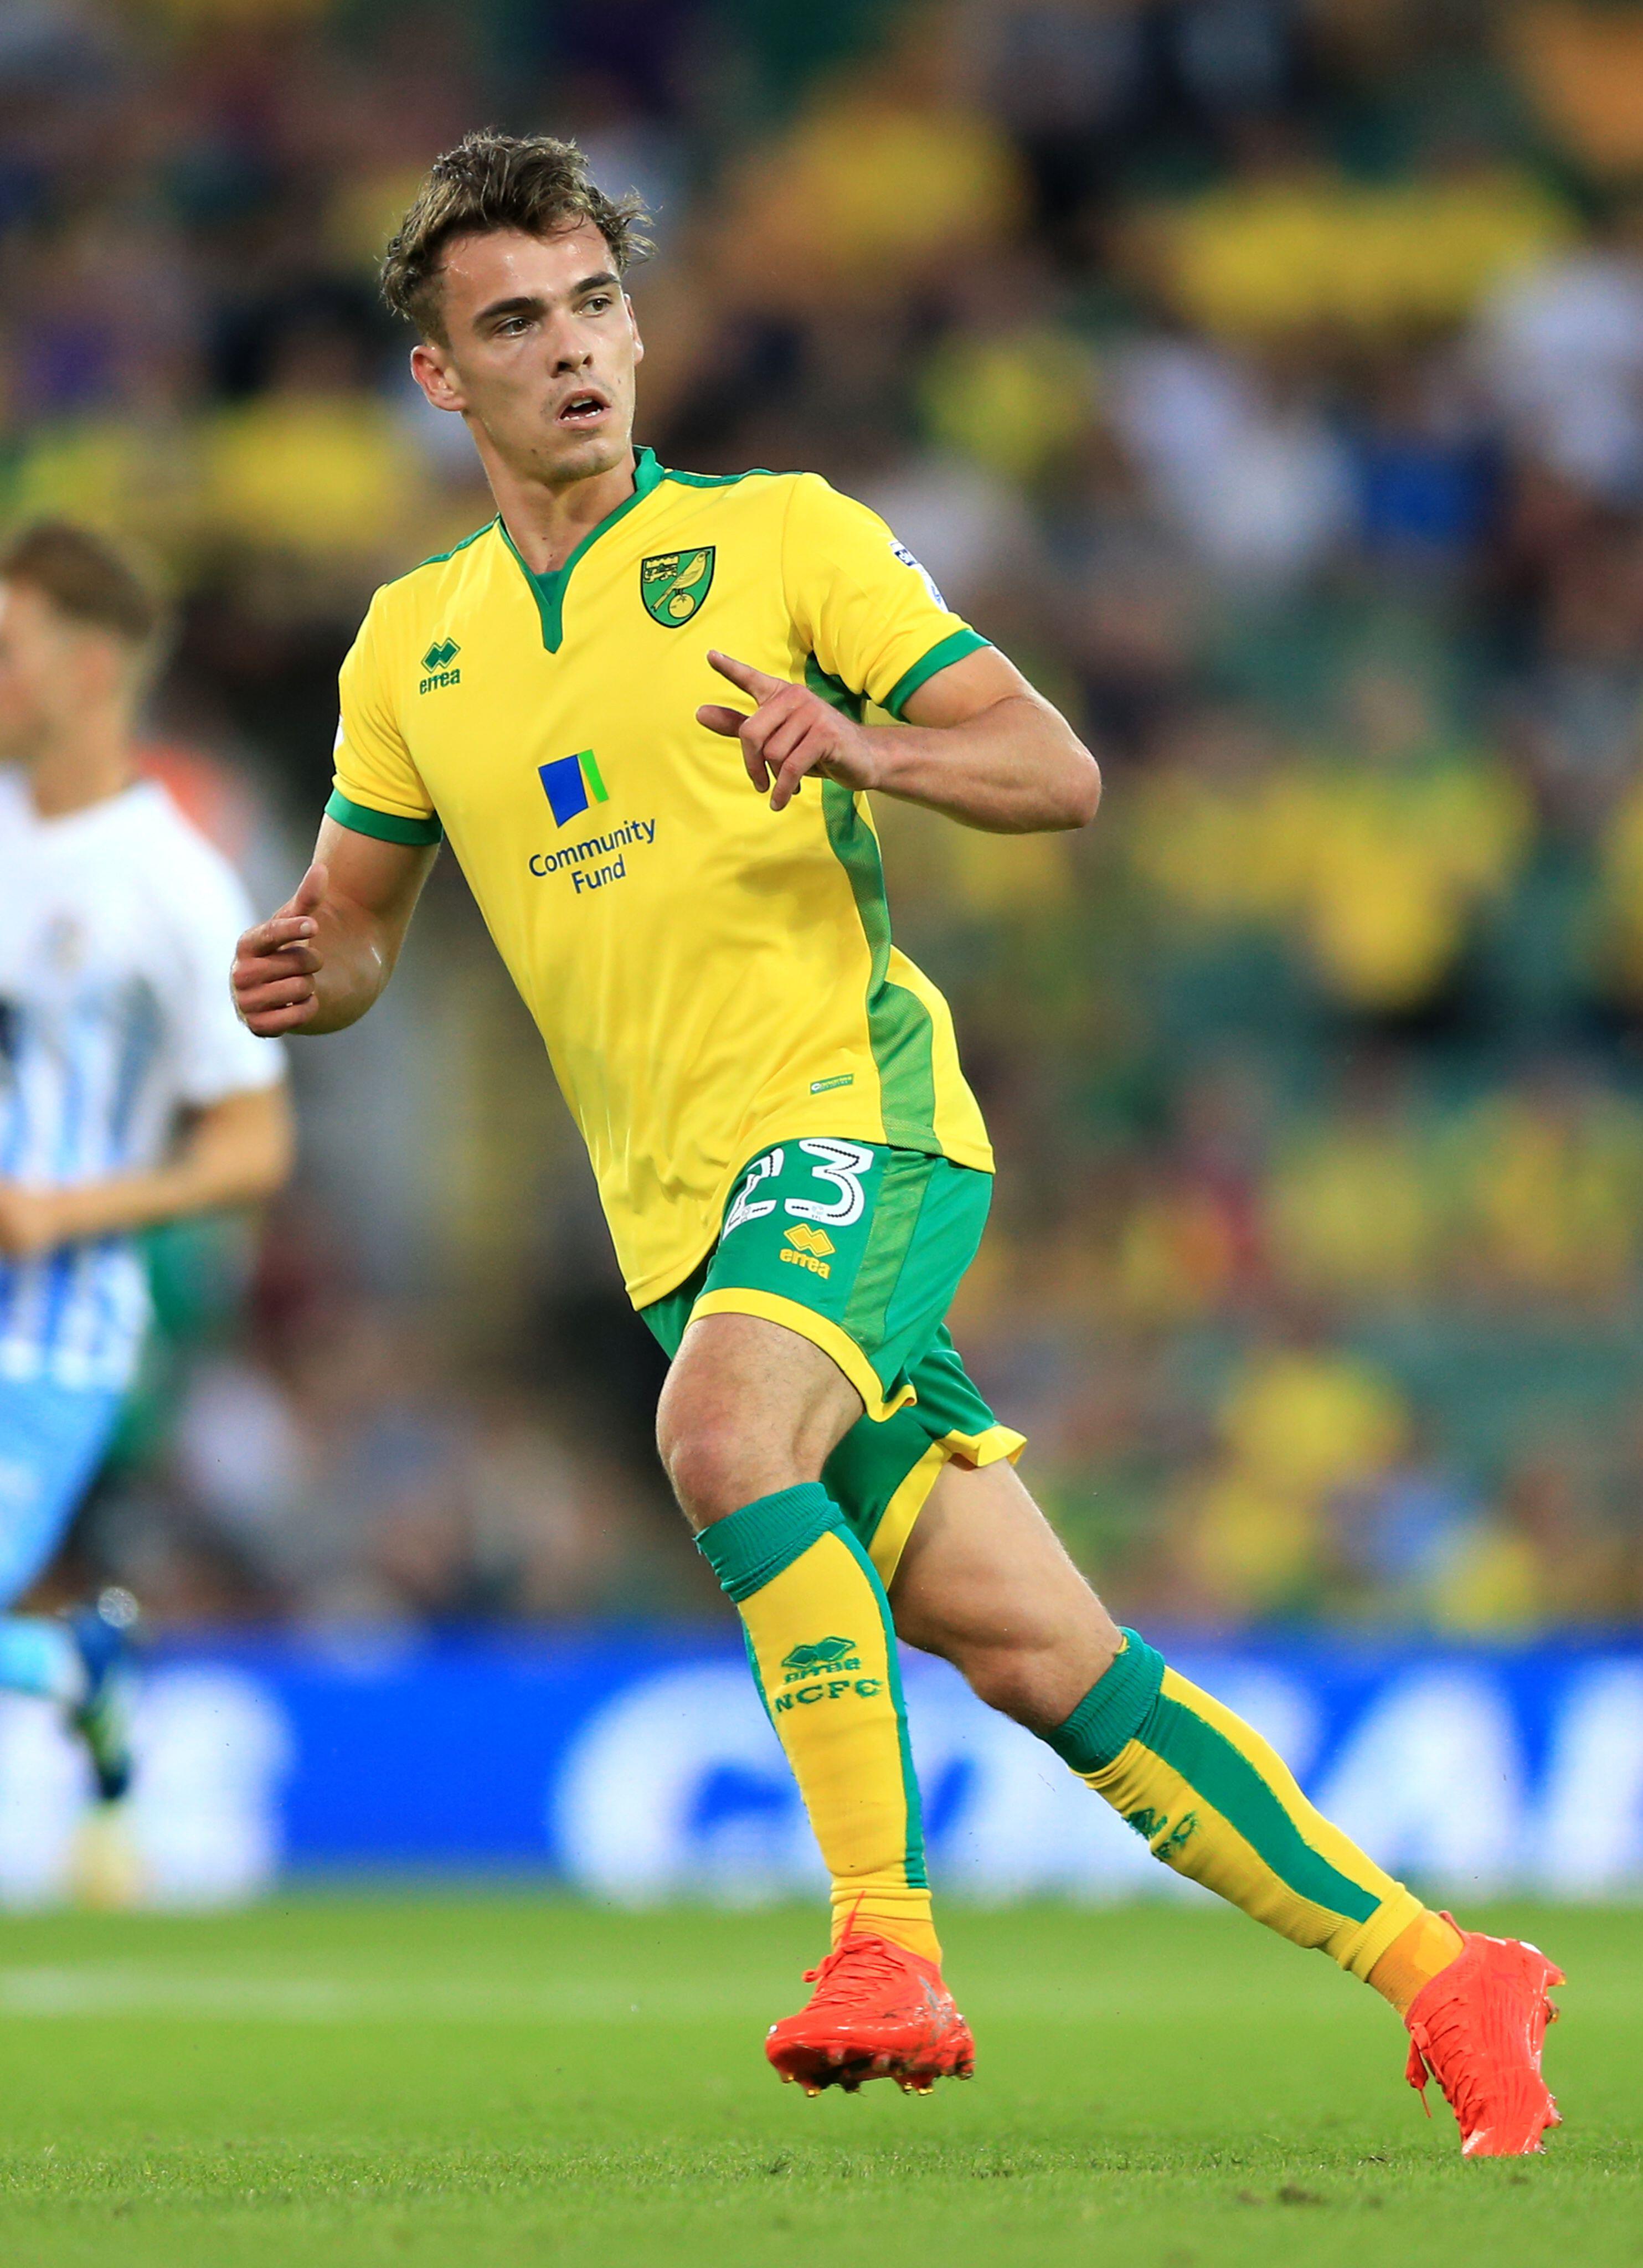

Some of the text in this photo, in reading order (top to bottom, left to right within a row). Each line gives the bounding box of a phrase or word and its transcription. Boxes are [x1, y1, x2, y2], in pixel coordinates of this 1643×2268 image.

[528, 818, 655, 877] Community
[571, 853, 626, 894] Fund
[722, 1138, 874, 1241] 23
[775, 1678, 883, 1713] NCFC
